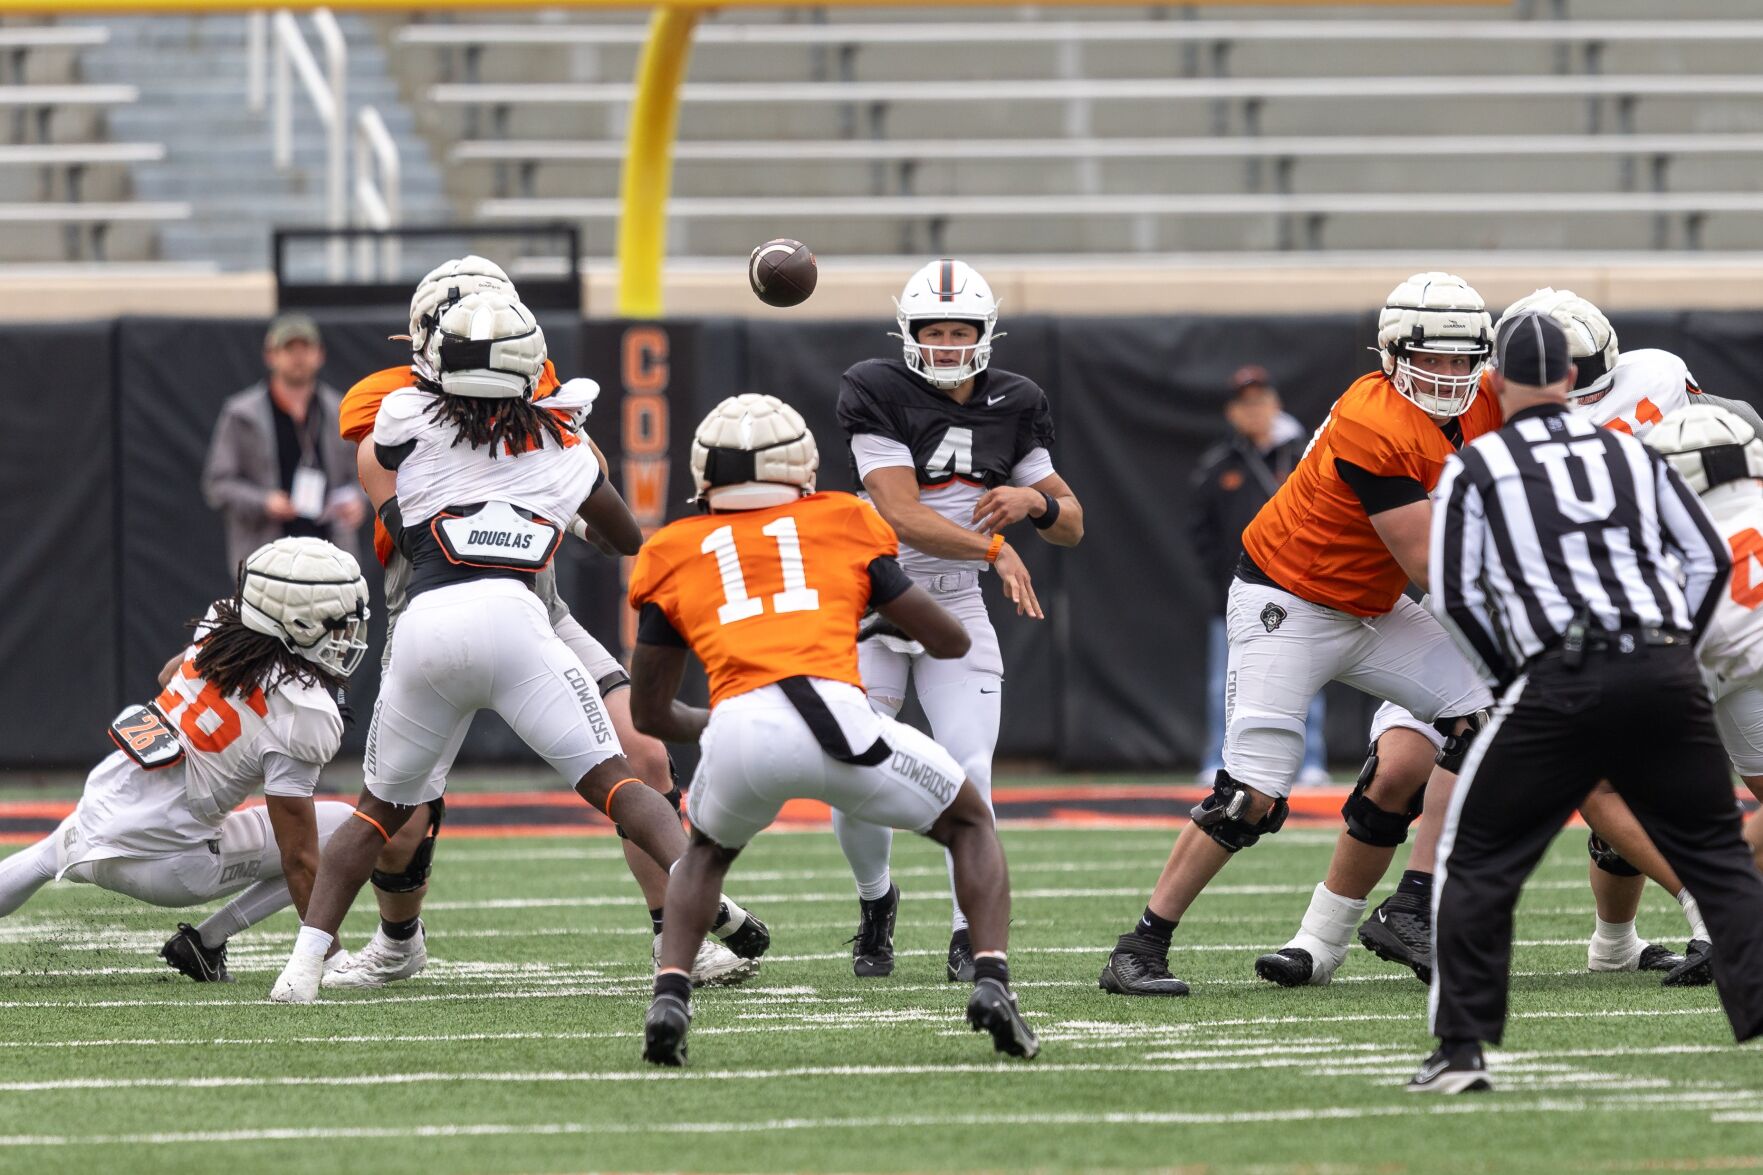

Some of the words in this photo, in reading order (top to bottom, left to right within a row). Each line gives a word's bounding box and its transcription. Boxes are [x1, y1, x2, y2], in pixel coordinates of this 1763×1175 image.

[925, 426, 974, 477] 4
[1530, 438, 1617, 524] U
[467, 529, 533, 549] DOUGLAS
[700, 515, 820, 625] 11
[119, 714, 170, 751] 26
[367, 699, 383, 777] COWBOYS
[563, 667, 612, 745] COWBOYS
[891, 750, 957, 805] COWBOYS
